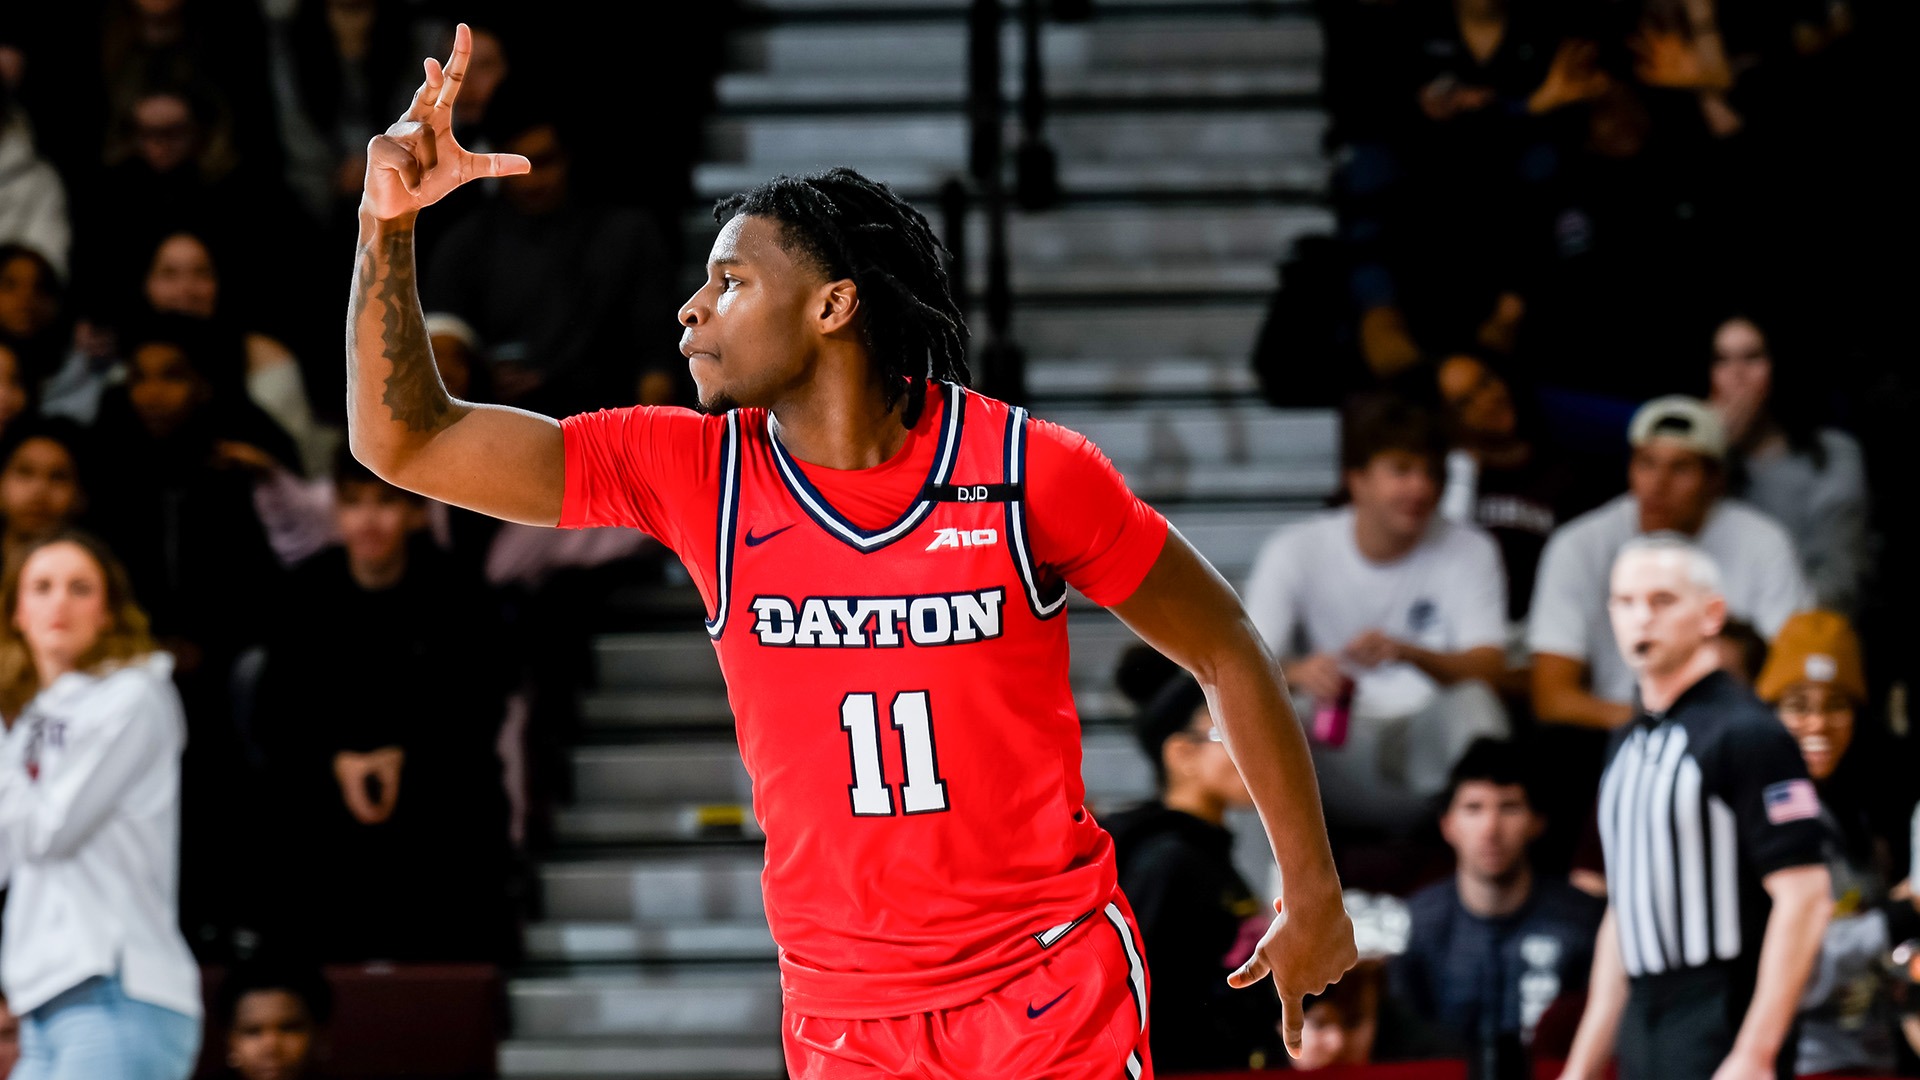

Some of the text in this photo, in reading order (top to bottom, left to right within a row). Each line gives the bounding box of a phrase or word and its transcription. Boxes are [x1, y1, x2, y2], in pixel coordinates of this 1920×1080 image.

[957, 486, 988, 501] DJD
[925, 527, 998, 552] A10
[751, 587, 1004, 647] DAYTON
[840, 690, 949, 816] 11
